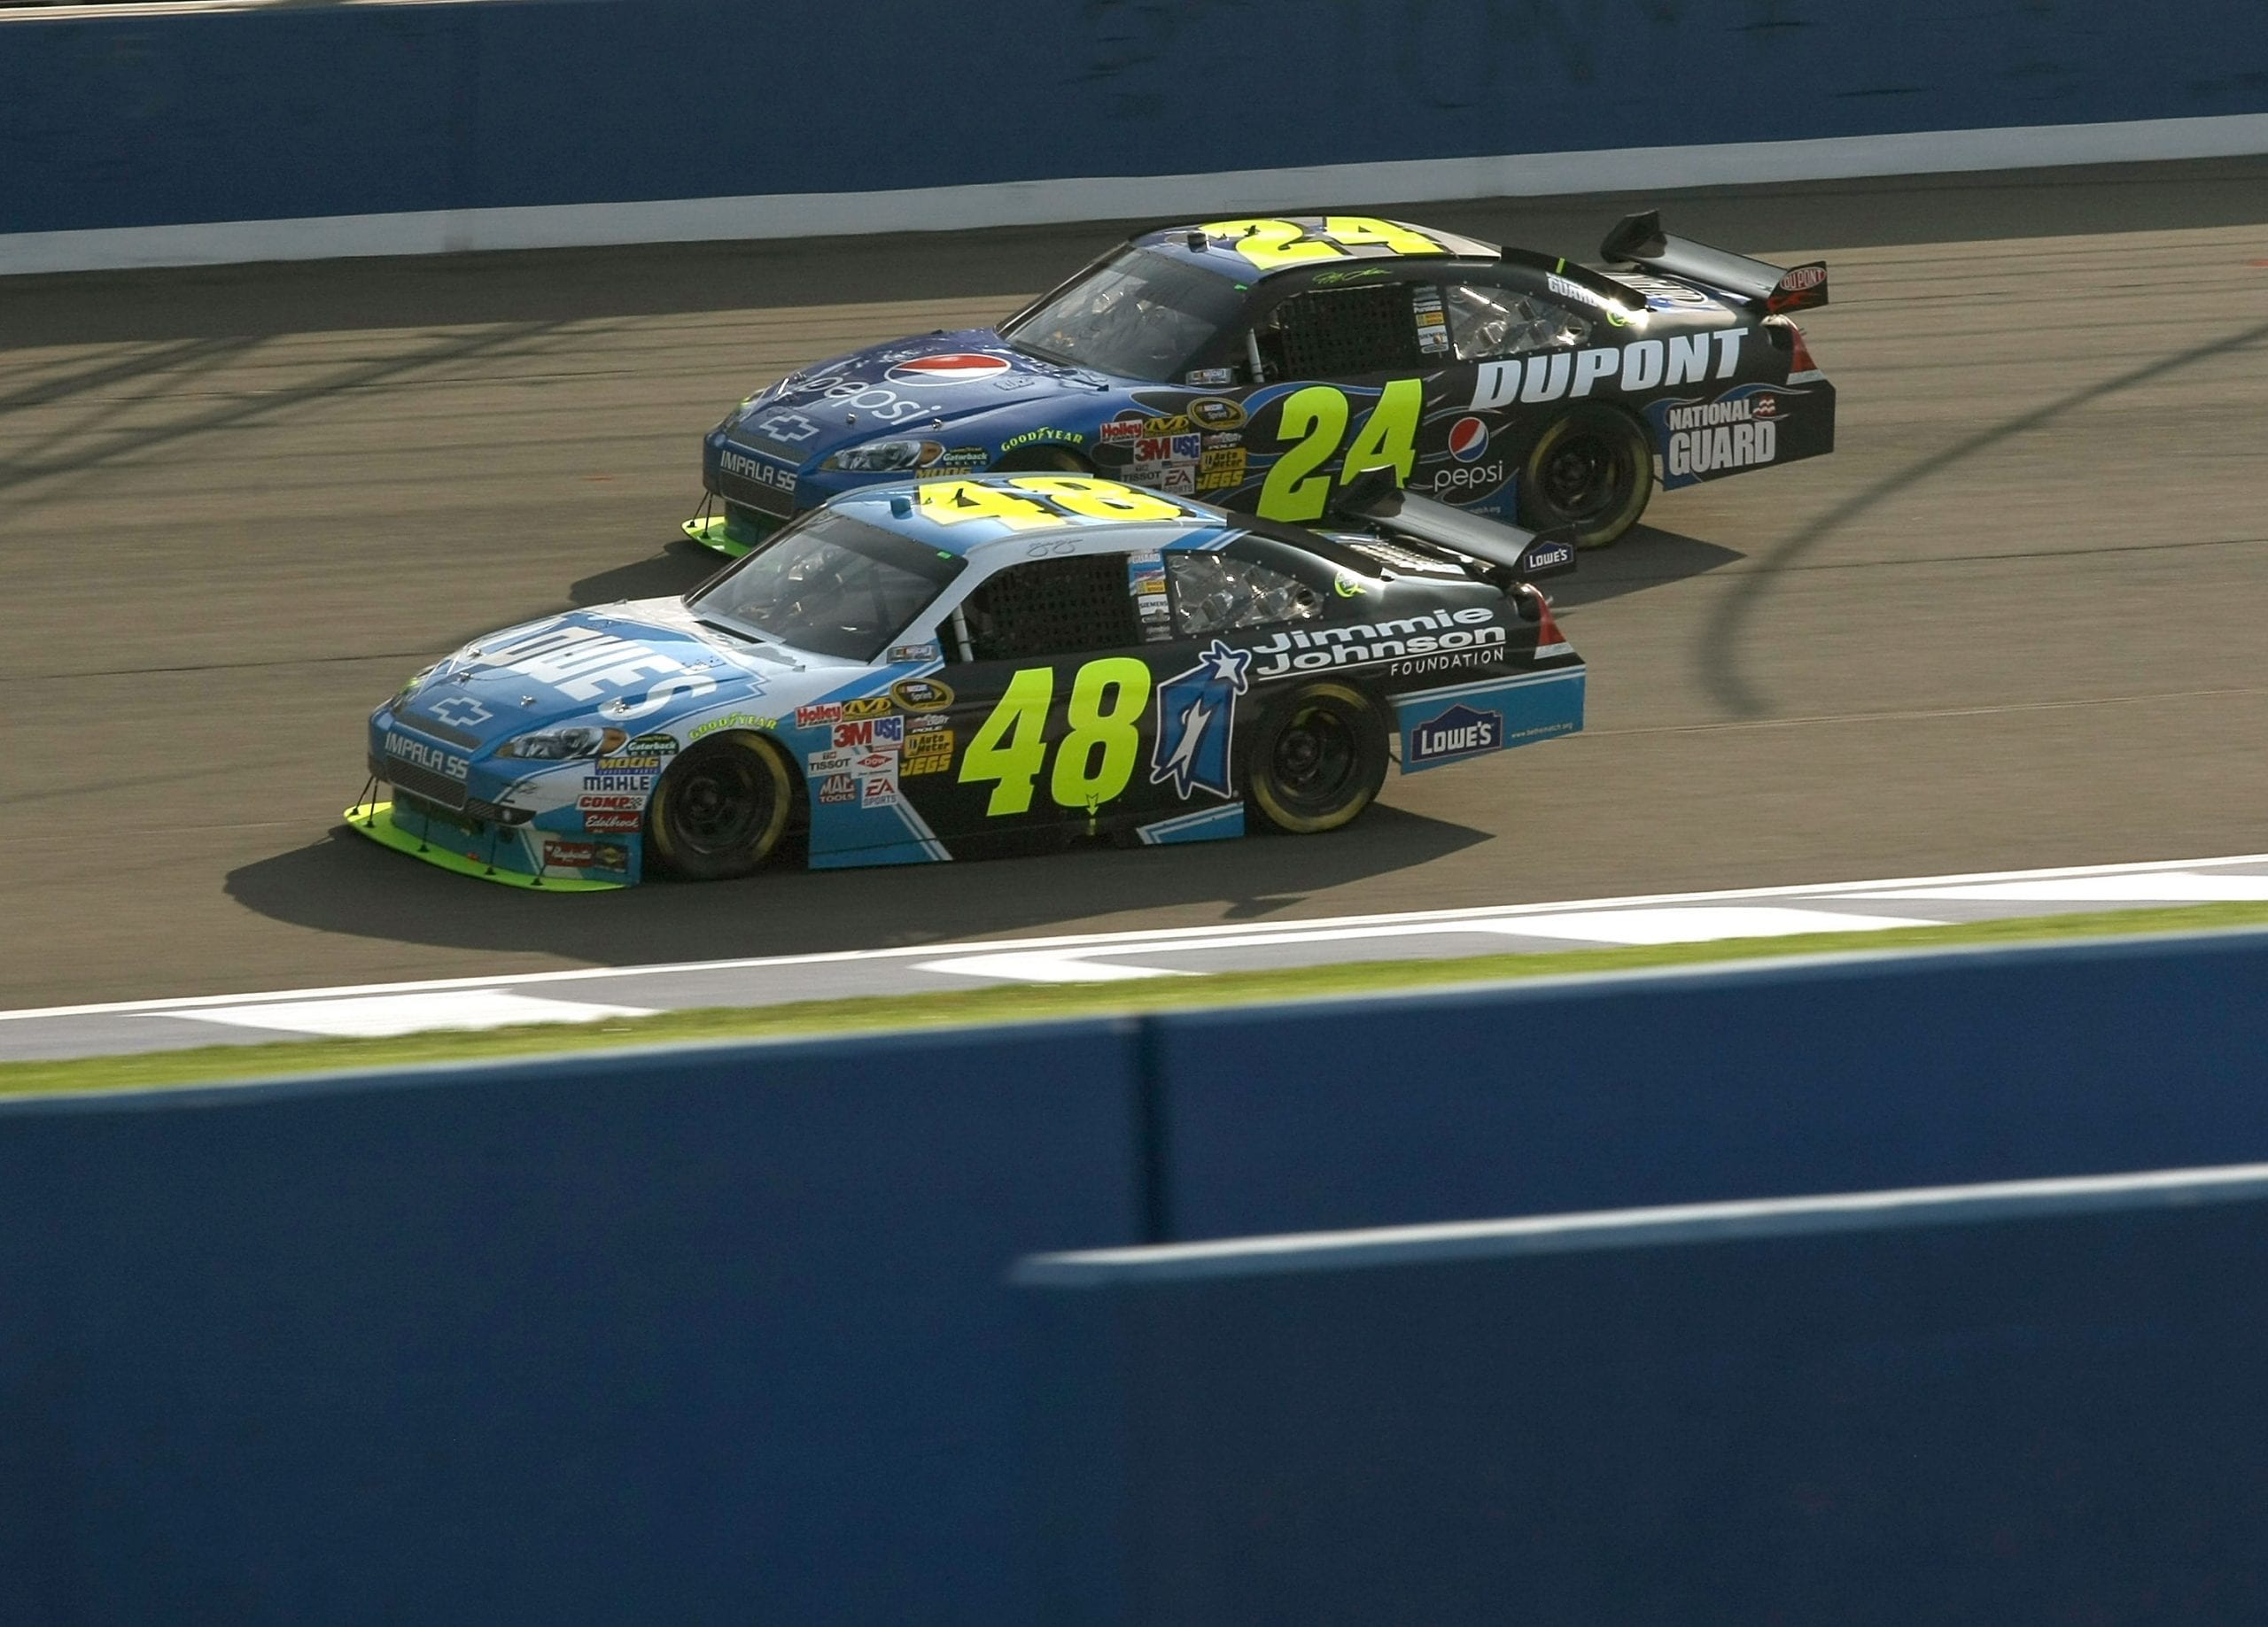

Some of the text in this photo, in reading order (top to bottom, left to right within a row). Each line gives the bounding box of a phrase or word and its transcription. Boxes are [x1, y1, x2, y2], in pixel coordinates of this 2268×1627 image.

[1197, 216, 1445, 270] 24
[1783, 269, 1823, 288] DUPONT
[1469, 328, 1749, 411] DUPONT
[1669, 399, 1752, 431] NATIONAL
[1000, 427, 1084, 452] GOODYEAR
[1101, 423, 1142, 438] Holley
[943, 452, 988, 461] Gatorback
[1135, 438, 1170, 461] 3M
[1172, 435, 1199, 458] USG
[1256, 378, 1423, 523] 24
[1669, 421, 1775, 476] GUARD
[720, 449, 797, 492] IMPALA SS
[1122, 470, 1161, 484] TISSOT
[1164, 469, 1192, 486] EA
[1196, 470, 1244, 490] JEGS
[1434, 461, 1503, 492] pepsi
[919, 476, 1182, 531] 48
[1529, 548, 1568, 569] LOWE'S
[1252, 608, 1495, 654] Jimmie
[1256, 626, 1506, 676] Johnson
[1390, 647, 1504, 676] FOUNDATION
[688, 712, 778, 740] GOODYEAR
[796, 706, 841, 724] Holley
[833, 717, 901, 748] 3M USG
[920, 734, 944, 743] Auto
[958, 657, 1151, 817] 48
[1421, 721, 1492, 755] LOWE'S
[384, 732, 470, 779] IMPALA SS
[627, 741, 677, 751] Gatorback
[917, 741, 951, 752] Meter
[598, 756, 659, 769] MOOG
[809, 758, 850, 771] TISSOT
[900, 755, 951, 777] JEGS
[584, 776, 649, 791] MAHLE
[819, 774, 895, 796] MAC EA
[579, 795, 631, 808] COMP
[819, 793, 856, 802] TOOLS
[585, 815, 640, 828] Edelbrock
